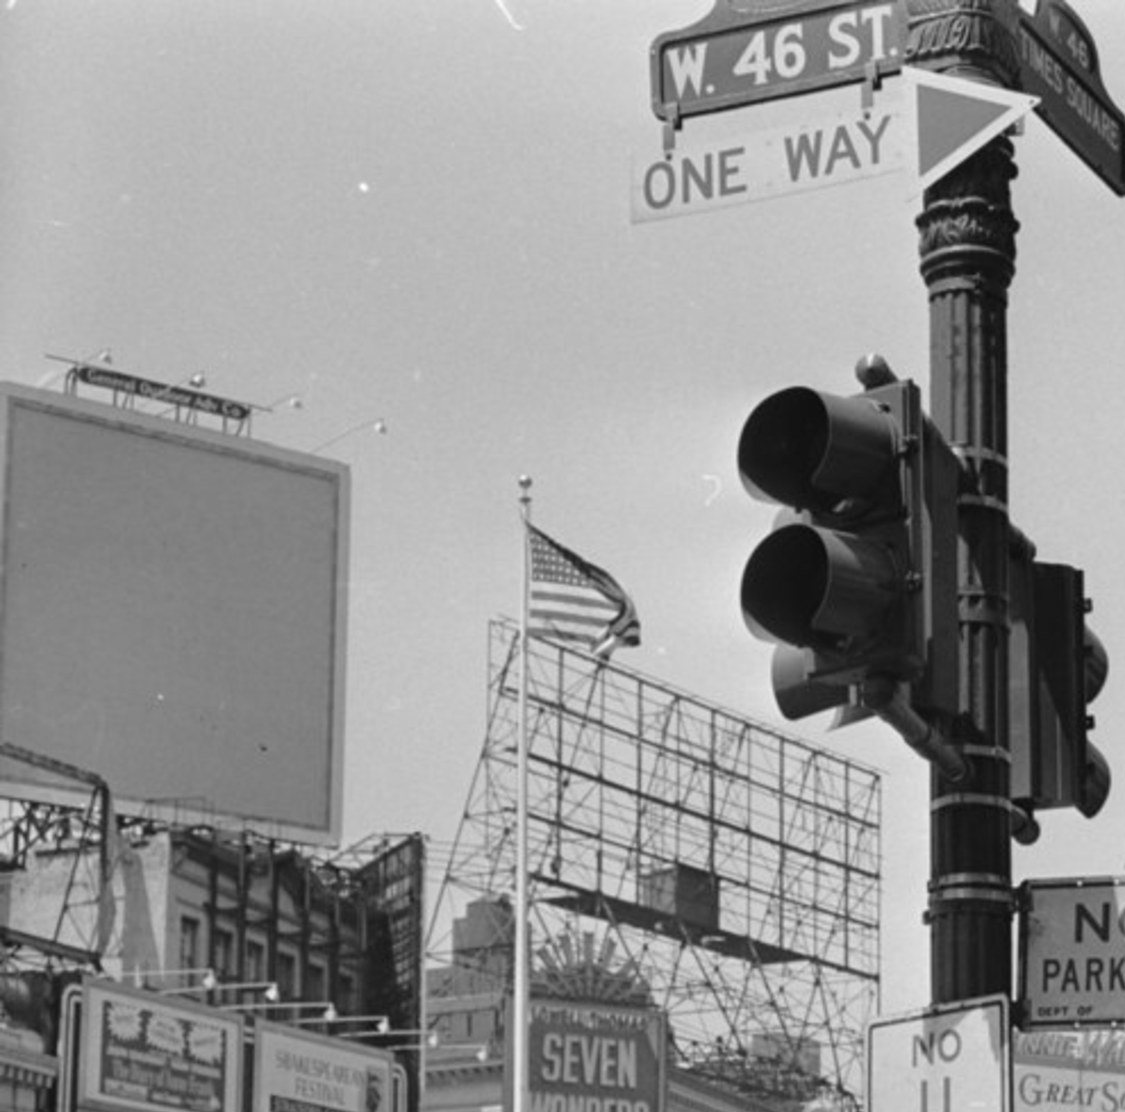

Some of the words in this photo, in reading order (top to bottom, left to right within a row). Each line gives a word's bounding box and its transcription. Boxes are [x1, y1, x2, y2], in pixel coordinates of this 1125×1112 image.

[666, 42, 715, 99] W.
[732, 22, 806, 86] 46
[827, 5, 899, 70] ST.
[1018, 23, 1063, 94] TIMES
[1066, 76, 1120, 150] SQUARE
[643, 146, 748, 210] ONE
[784, 115, 892, 183] WAY
[1037, 1006, 1068, 1016] DEPT
[1077, 1005, 1093, 1016] OF
[541, 1031, 638, 1089] SEVEN
[911, 1029, 961, 1068] NO
[1019, 1073, 1098, 1107] GREAT
